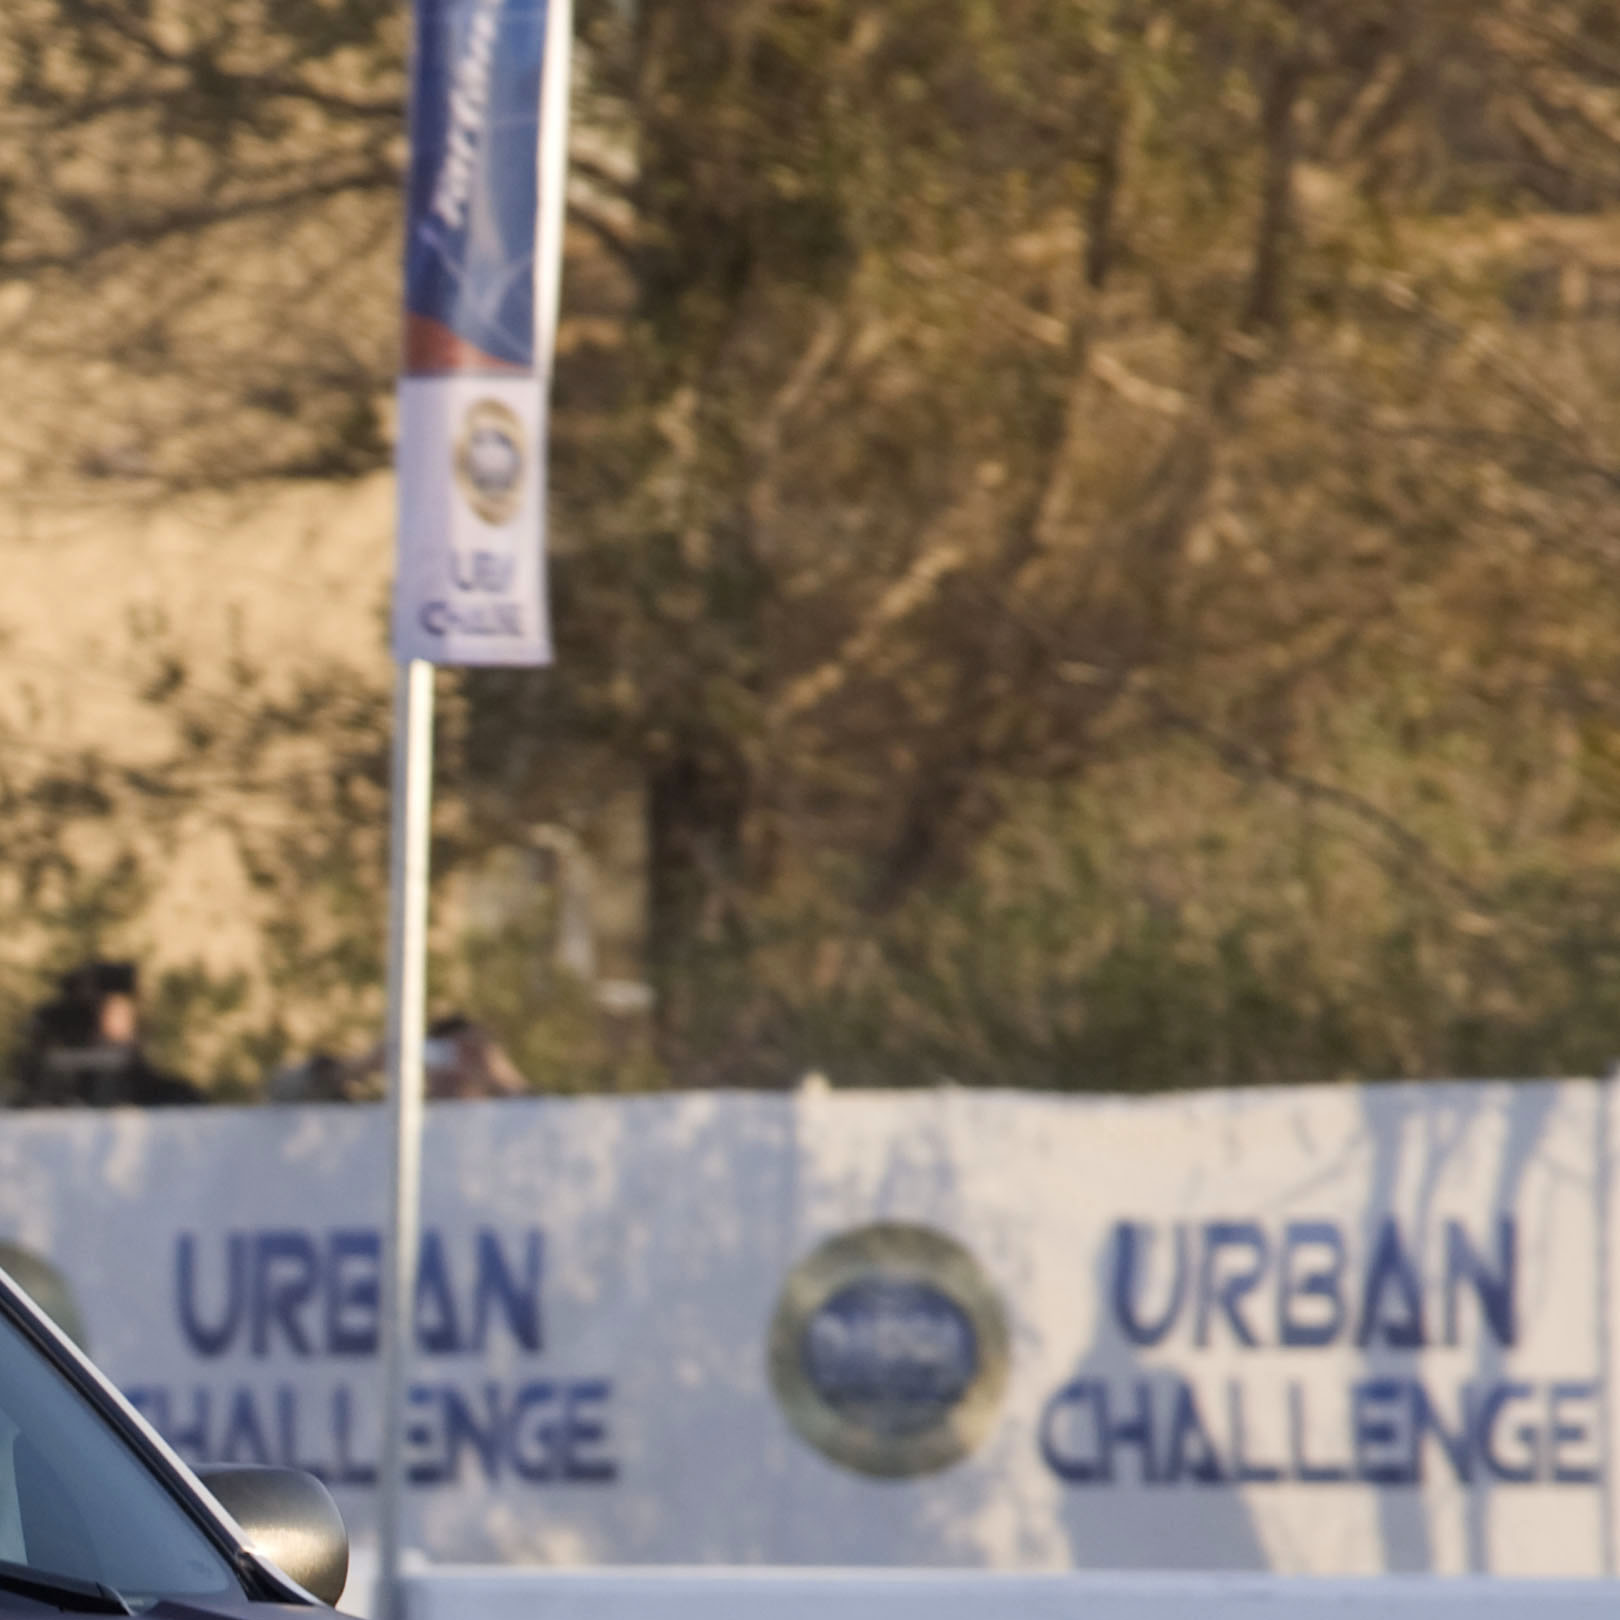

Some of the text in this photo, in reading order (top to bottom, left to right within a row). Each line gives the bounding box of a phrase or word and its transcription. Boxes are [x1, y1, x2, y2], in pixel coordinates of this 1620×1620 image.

[172, 1227, 547, 1358] URBAN
[1110, 1215, 1521, 1350] URBAN
[124, 1379, 621, 1487] HALLENGE
[1037, 1376, 1603, 1487] CHALLENGE
